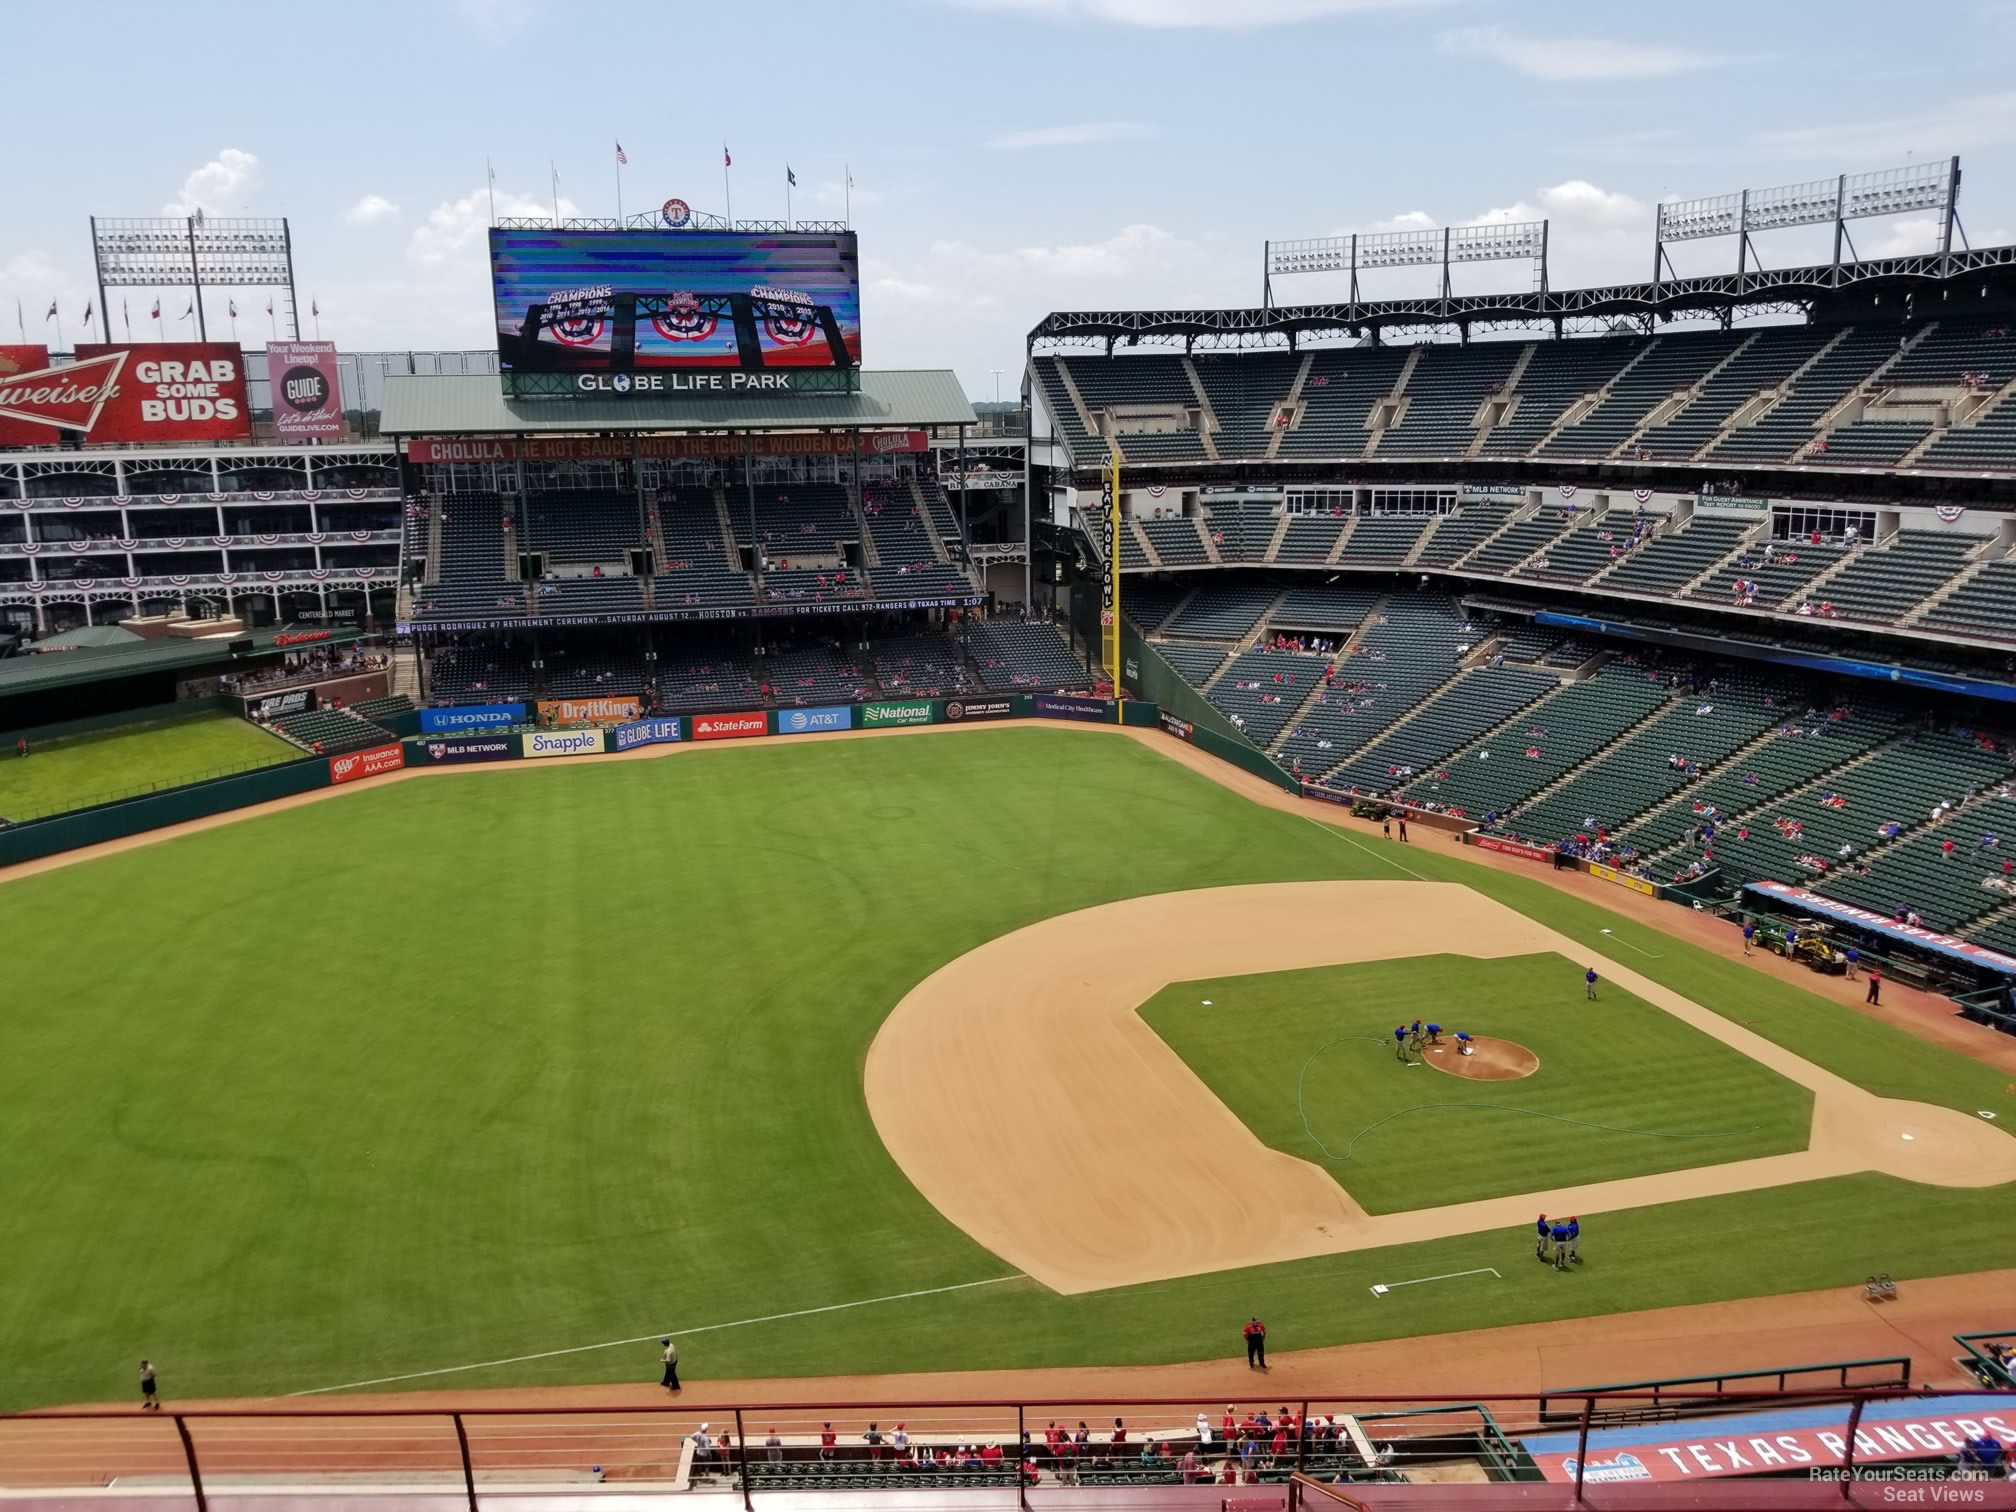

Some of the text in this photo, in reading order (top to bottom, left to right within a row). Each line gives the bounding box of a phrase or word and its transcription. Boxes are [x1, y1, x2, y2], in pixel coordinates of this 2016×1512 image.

[671, 208, 681, 219] T
[548, 288, 612, 304] CHAMPIONS
[752, 288, 814, 306] CHAMPIONS
[767, 303, 784, 311] 2010
[268, 343, 333, 353] Your Weekend
[284, 354, 318, 365] Lineup!
[136, 360, 235, 384] GRAB
[287, 377, 322, 399] GUIDE
[672, 374, 722, 390] LIFE
[730, 373, 789, 390] PARK
[156, 383, 219, 398] SOME
[141, 398, 238, 422] BUDS
[431, 442, 504, 460] CHOLULA
[511, 441, 539, 457] THE
[548, 441, 575, 457] HOT
[581, 439, 632, 457] SAUCE
[640, 438, 676, 455] WITH
[681, 438, 709, 454] THE
[769, 437, 832, 452] WOODEN
[872, 434, 909, 451] CHOLULA
[950, 480, 1016, 489] RIA CABANA
[1490, 486, 1519, 494] NETWORK
[334, 609, 355, 617] MARKET
[412, 623, 438, 631] PUDGE
[441, 622, 487, 631] RODRIGUEZ
[490, 621, 500, 629] #7
[503, 619, 553, 628] RETIREMENT
[649, 613, 678, 621] AUGUST
[751, 607, 795, 617] RANGERS
[812, 605, 840, 613] TICKETS
[843, 604, 860, 612] CALL
[861, 602, 907, 611] 972-RANGERS
[917, 600, 938, 608] TEXAS
[963, 597, 982, 606] 1:07
[563, 701, 638, 718] DraftKings
[880, 705, 929, 719] National
[988, 702, 1010, 710] JOHN'S
[1045, 703, 1064, 711] Medical
[1065, 704, 1075, 712] City
[450, 712, 512, 724] HONDA
[810, 713, 839, 725] AT&T
[627, 722, 678, 743] GLOBE LIFE
[447, 746, 465, 754] MLB
[467, 743, 508, 753] NETWORK
[533, 732, 595, 752] Snapple
[363, 748, 400, 762] Insurance
[365, 758, 400, 773] AAA.com
[1794, 894, 1968, 950] TEXAS RANGERS
[1658, 1417, 2016, 1474] TEXAS RANGERS
